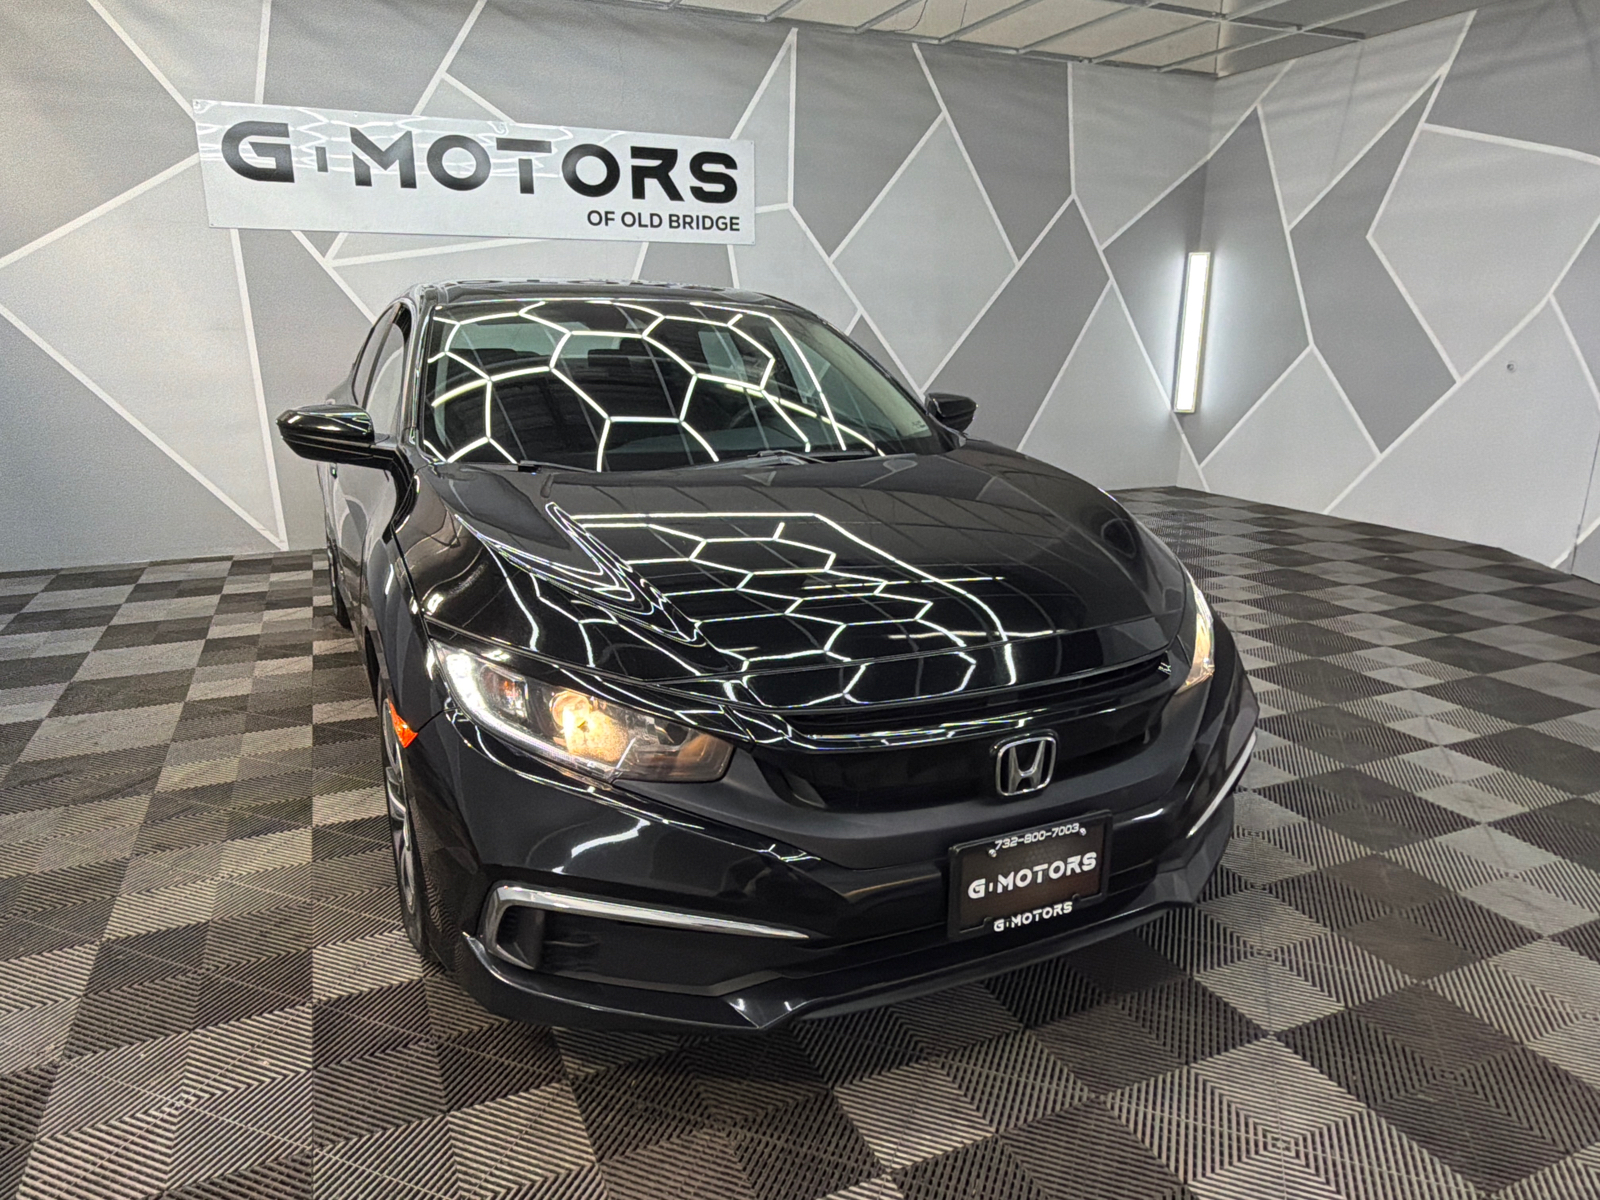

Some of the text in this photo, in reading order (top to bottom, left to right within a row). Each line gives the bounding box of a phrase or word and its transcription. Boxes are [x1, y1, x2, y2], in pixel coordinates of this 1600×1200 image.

[587, 210, 740, 231] OF OLD BRIDGE
[994, 822, 1080, 851] 732-800-7003
